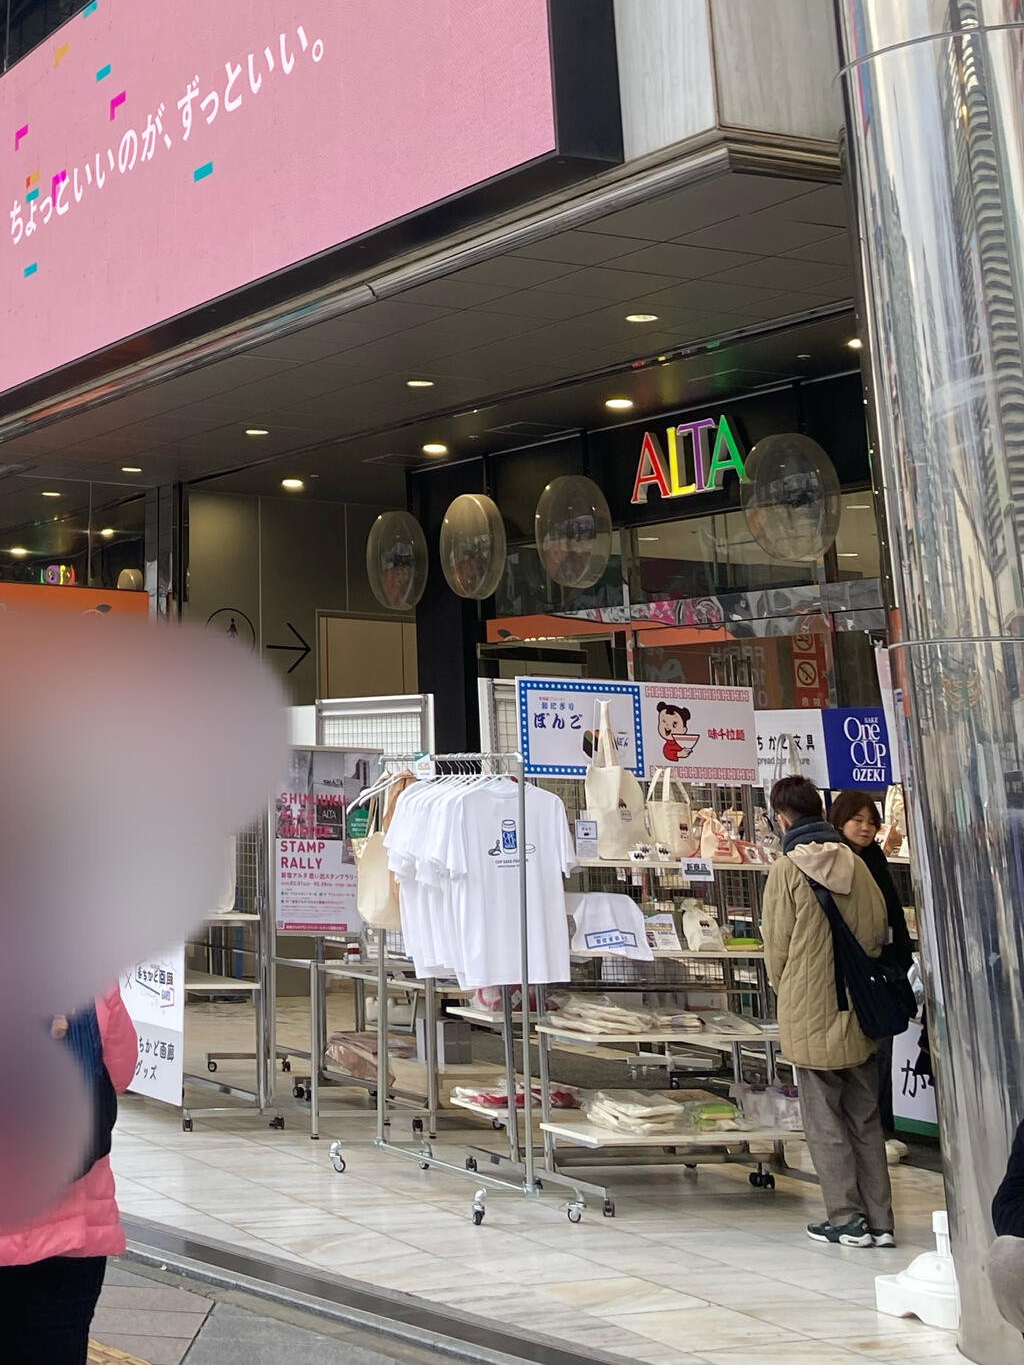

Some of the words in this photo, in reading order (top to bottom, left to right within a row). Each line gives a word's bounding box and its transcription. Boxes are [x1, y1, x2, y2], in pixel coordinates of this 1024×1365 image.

[9, 25, 324, 245] ちょっといいのが、ずっといい。
[630, 414, 750, 504] ALTA
[534, 712, 583, 730] ぼんご
[843, 717, 880, 742] One
[850, 740, 886, 767] CUP
[852, 768, 885, 782] OZEKI
[280, 840, 325, 853] STAMP
[280, 856, 323, 869] RALLY
